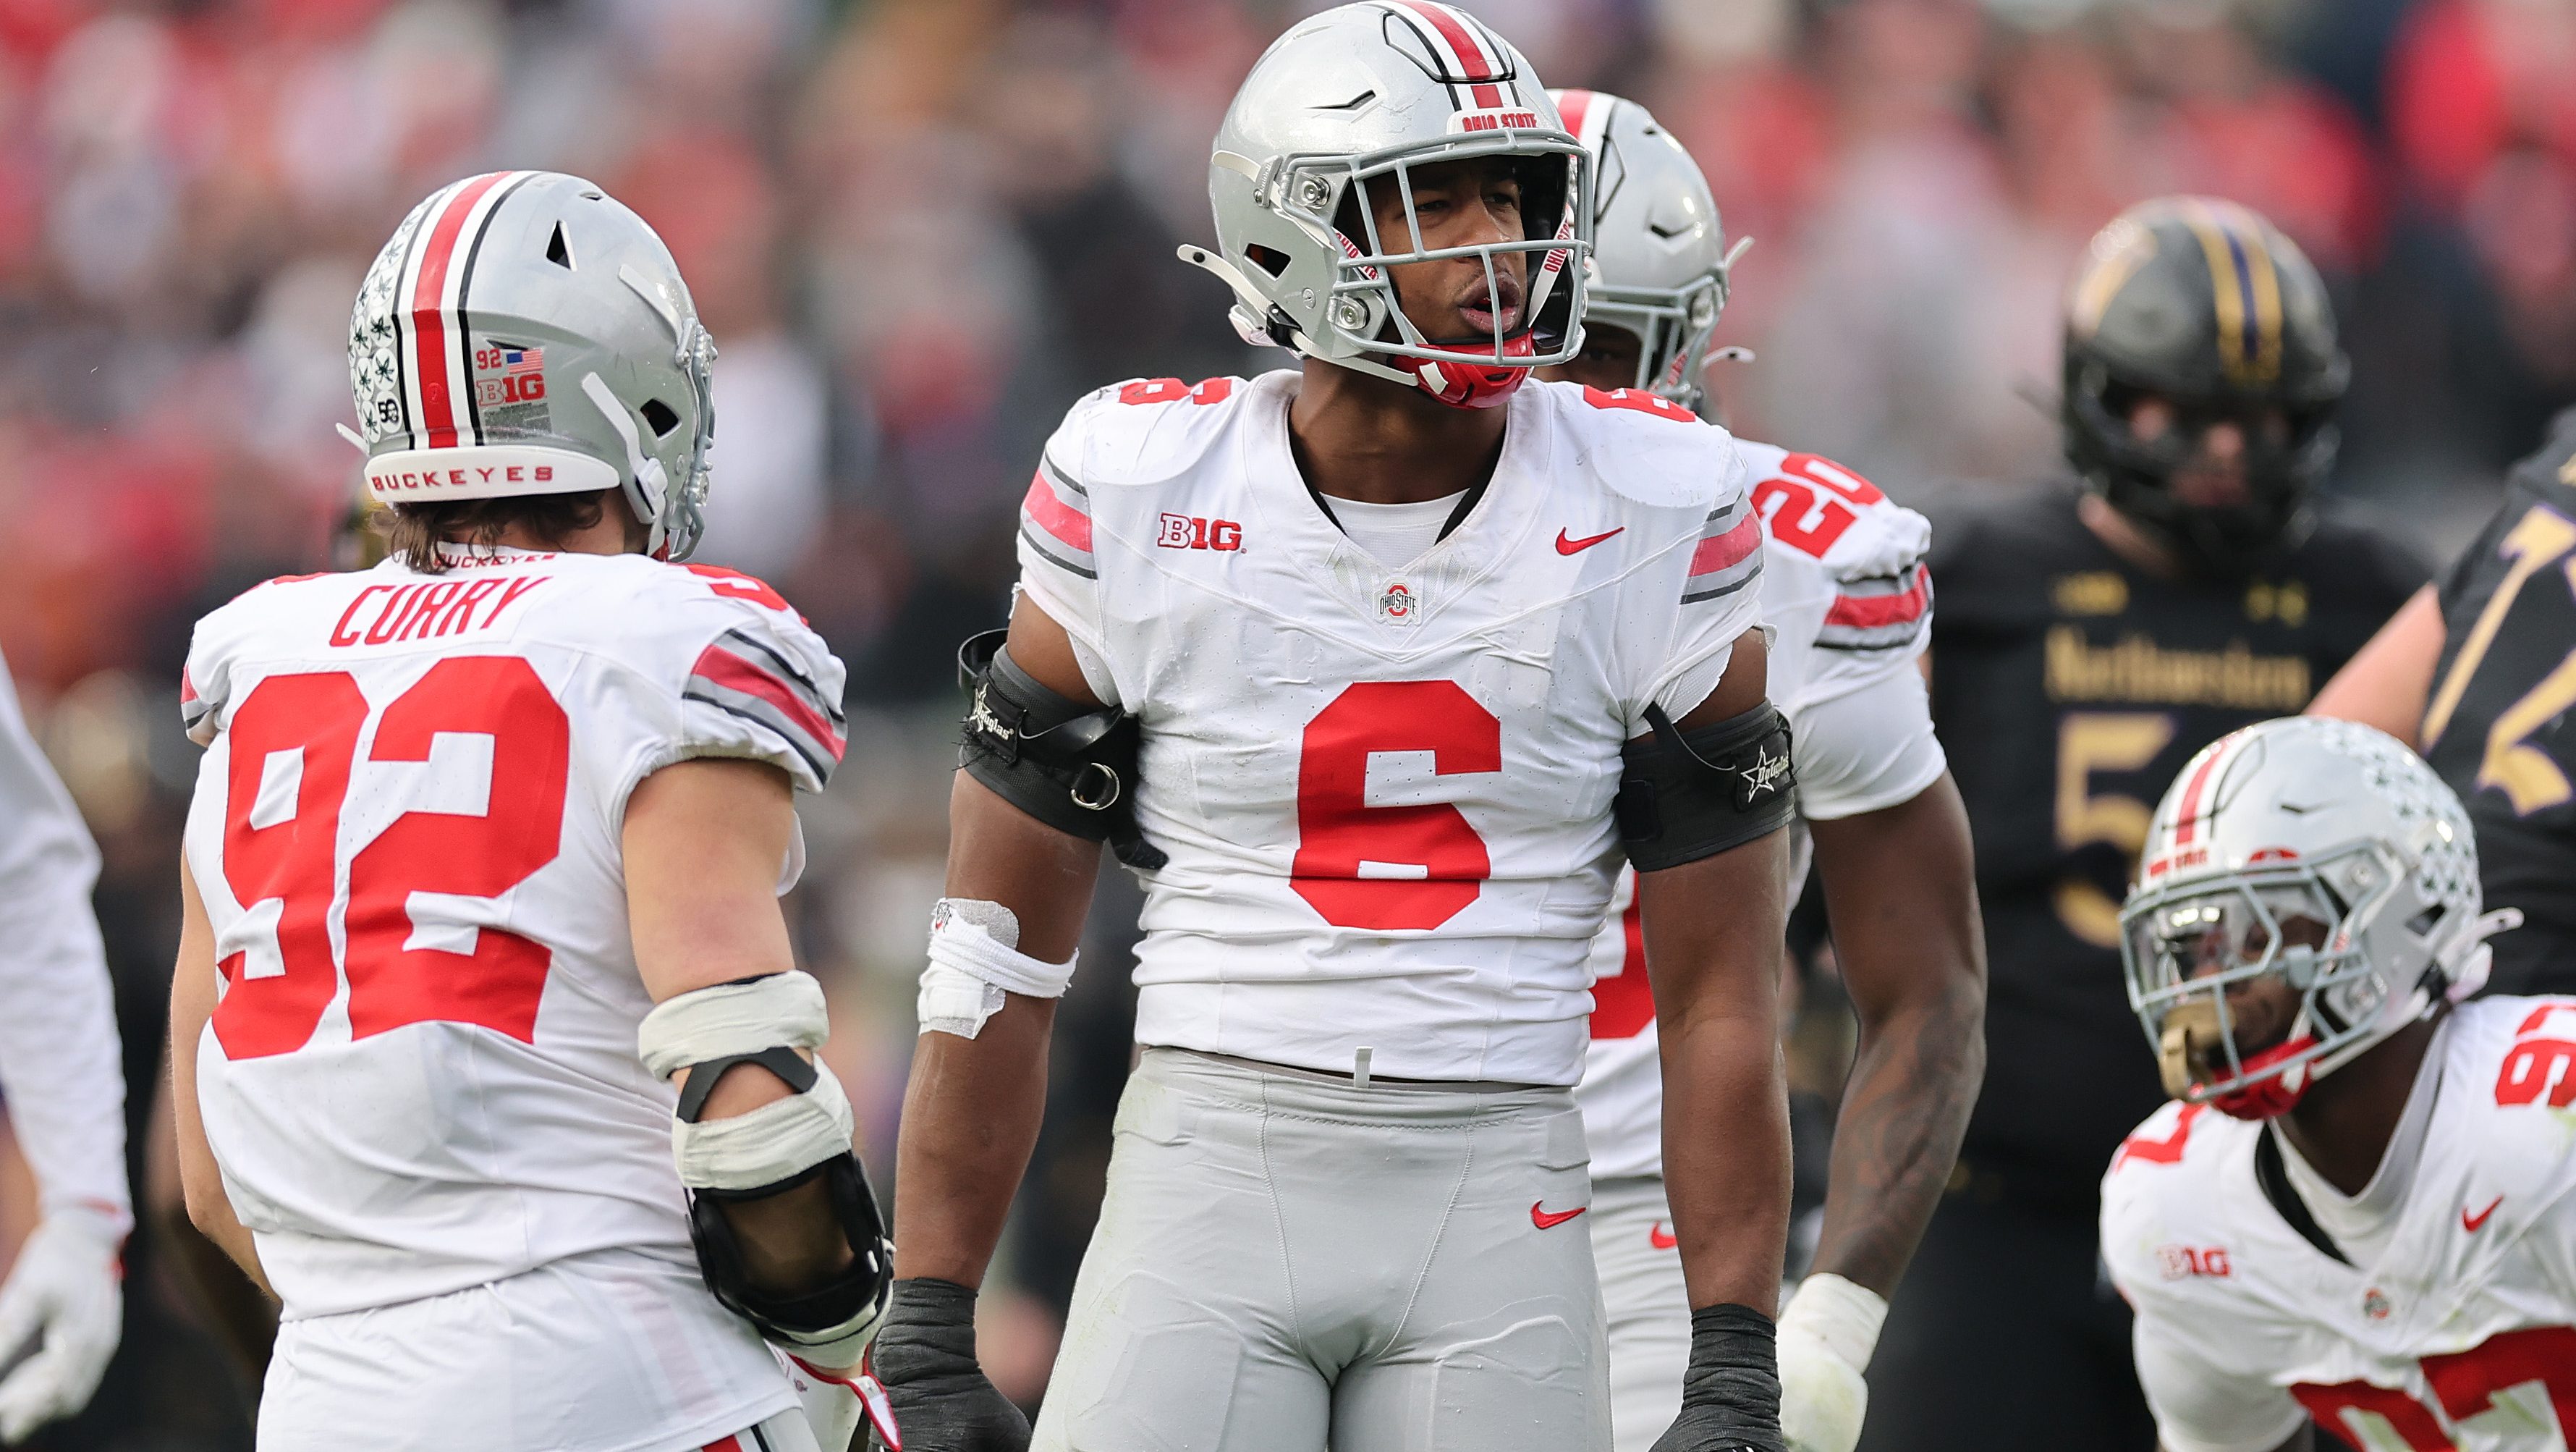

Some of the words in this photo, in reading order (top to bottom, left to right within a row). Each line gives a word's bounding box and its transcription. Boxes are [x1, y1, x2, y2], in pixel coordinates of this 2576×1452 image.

[1462, 114, 1498, 132] OHIO
[1501, 113, 1536, 128] STATE
[476, 348, 502, 370] 92
[371, 466, 553, 491] BUCKEYES
[1750, 451, 1886, 560] 20
[329, 576, 554, 646] CURRY
[1289, 680, 1501, 930] 6
[211, 655, 569, 1061] 92
